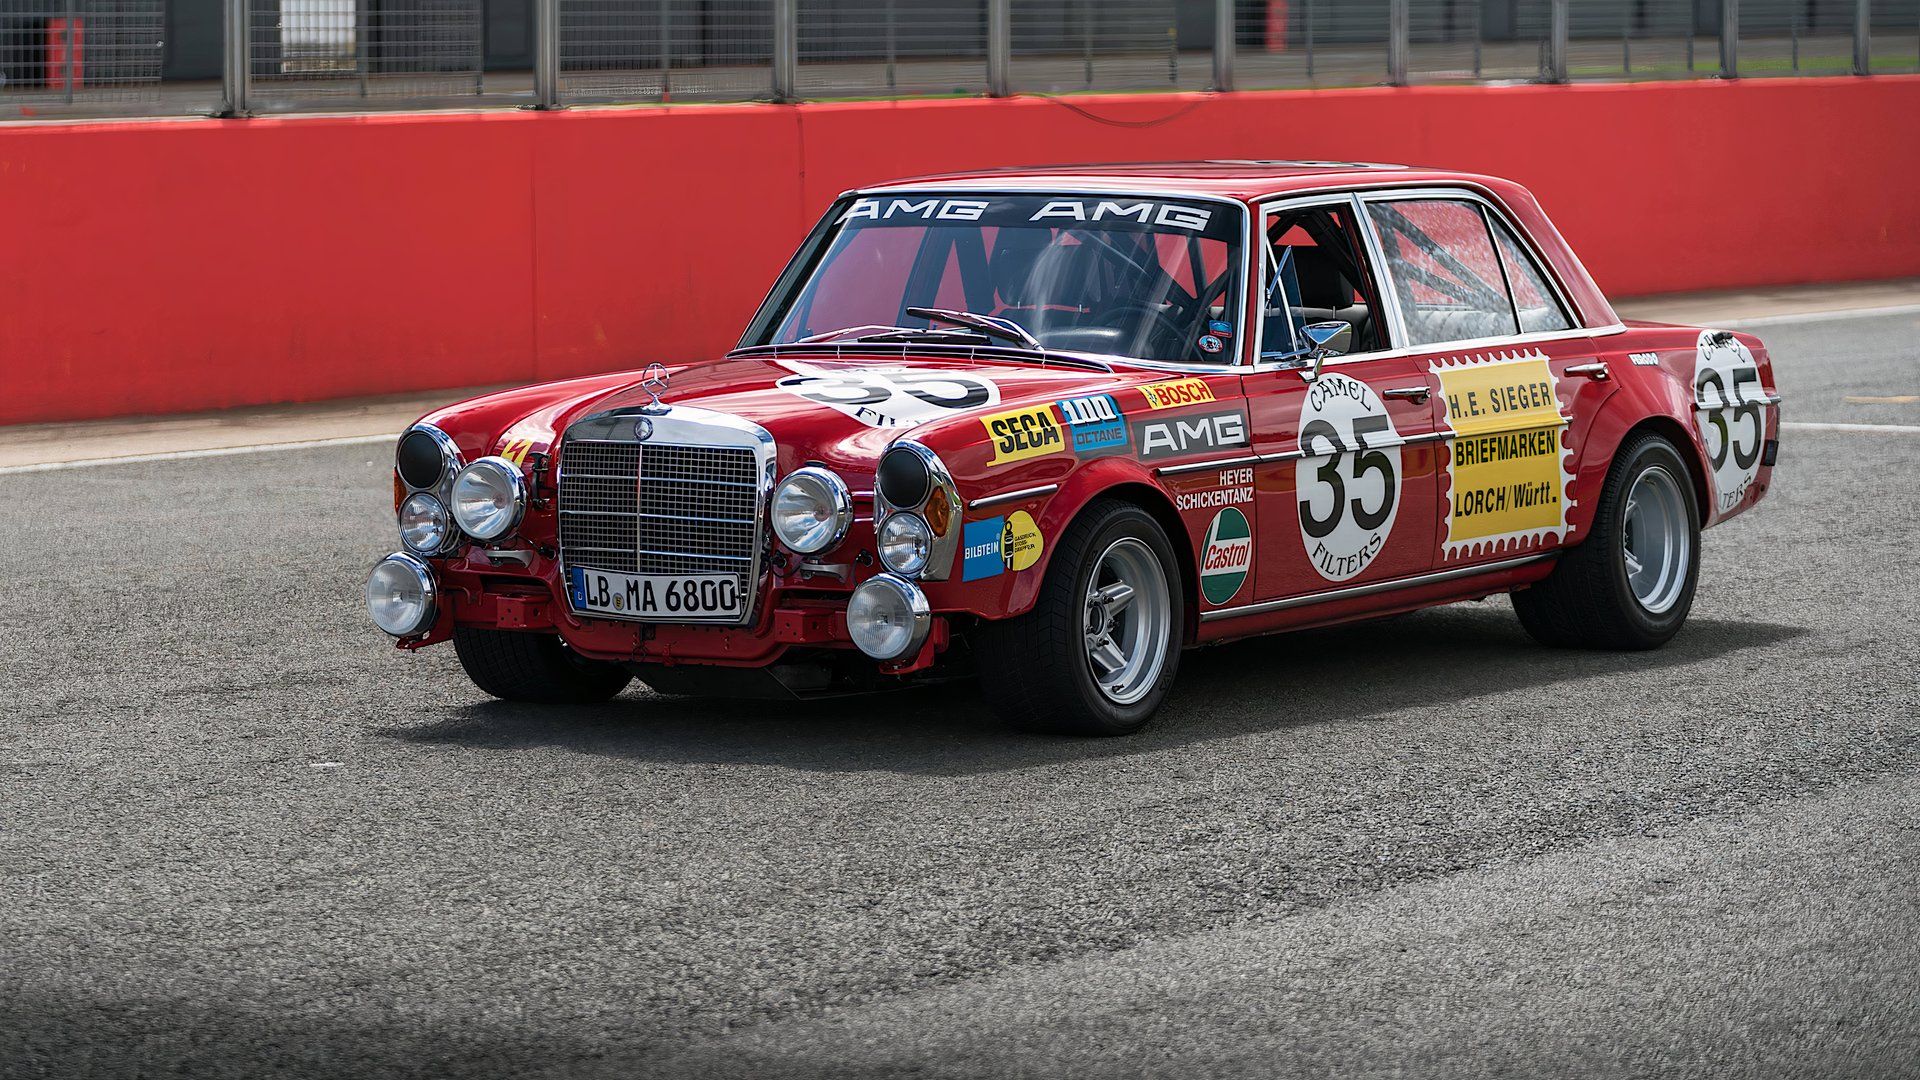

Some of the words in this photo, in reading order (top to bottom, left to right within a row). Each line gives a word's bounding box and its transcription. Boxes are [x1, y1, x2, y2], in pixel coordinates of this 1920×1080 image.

[833, 199, 990, 224] AMG
[1029, 201, 1213, 231] AMG
[780, 373, 990, 409] 35
[1153, 382, 1212, 406] BOSCH
[1310, 377, 1372, 412] CAMEL
[1448, 391, 1486, 420] H.E.
[1490, 382, 1552, 414] SIEGER
[1062, 395, 1117, 425] 100
[1696, 367, 1762, 473] 35
[991, 411, 1061, 454] SECA
[1076, 427, 1123, 446] OCTANE
[1143, 414, 1246, 455] AMG
[1455, 429, 1556, 467] BRIEFMARKEN
[1219, 468, 1254, 487] HEYER
[1299, 414, 1396, 539] 35
[1176, 487, 1254, 511] SCHICKENTANZ
[1455, 481, 1557, 517] LORCH/Württ.
[964, 541, 999, 560] BILSTEIN
[1204, 541, 1251, 571] Castrol
[1312, 532, 1383, 577] FILTERS
[585, 573, 610, 607] LB
[626, 579, 657, 612] MA
[665, 579, 737, 612] 6800
